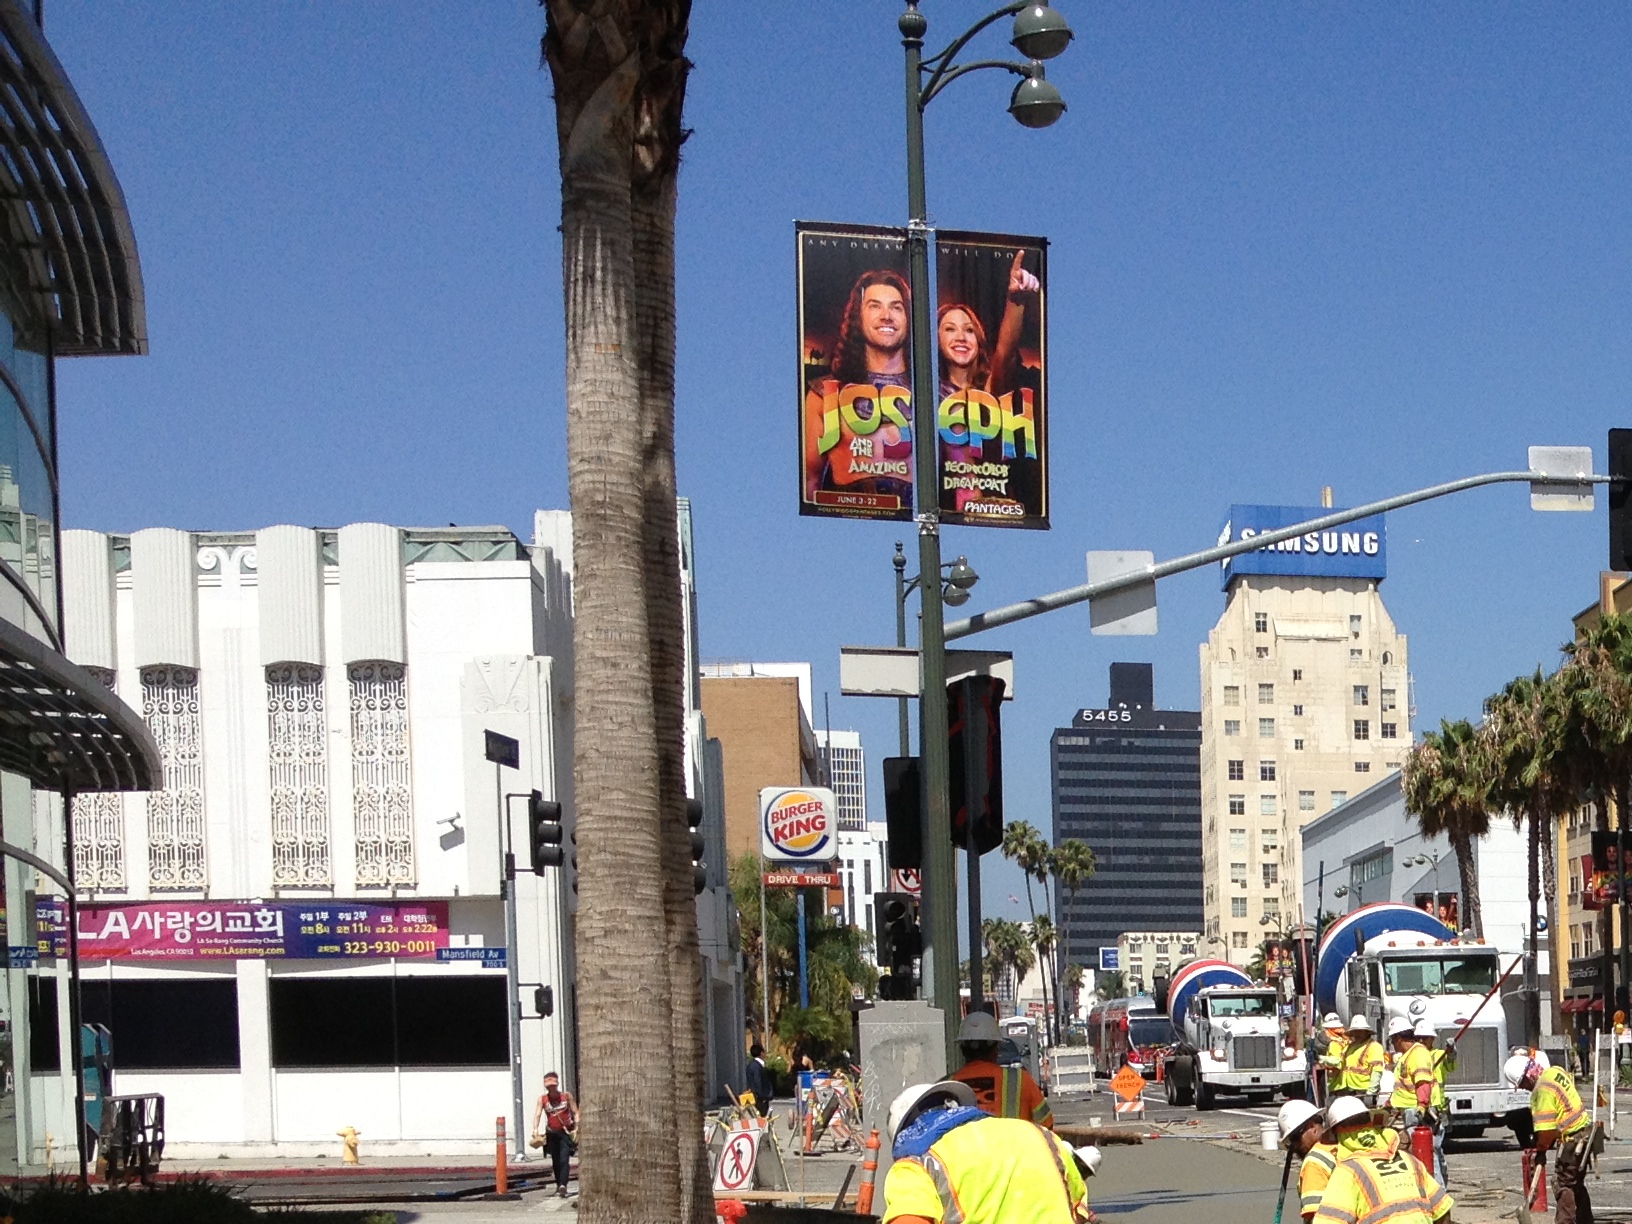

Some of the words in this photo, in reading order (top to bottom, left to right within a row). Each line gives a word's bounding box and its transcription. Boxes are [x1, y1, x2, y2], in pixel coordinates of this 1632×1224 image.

[808, 239, 838, 248] ANY
[850, 241, 903, 250] DREAM
[994, 251, 1014, 259] DO
[818, 380, 1037, 460] JOSEPH
[850, 437, 873, 450] AND
[852, 447, 873, 457] THE
[848, 459, 908, 475] AMAZING
[944, 477, 1009, 495] DREAMCOAT
[838, 496, 856, 504] JUNE
[964, 501, 1024, 515] PANTAGES
[1082, 710, 1132, 722] 5455
[771, 801, 823, 824] BURGER
[773, 814, 826, 844] KING
[768, 875, 799, 884] DRIVE
[804, 875, 831, 884] THRU
[199, 947, 285, 957] www.LAsarang.com
[343, 940, 436, 954] 323-930-0011
[442, 950, 484, 959] Mansfield
[1116, 1081, 1141, 1089] TRENCH
